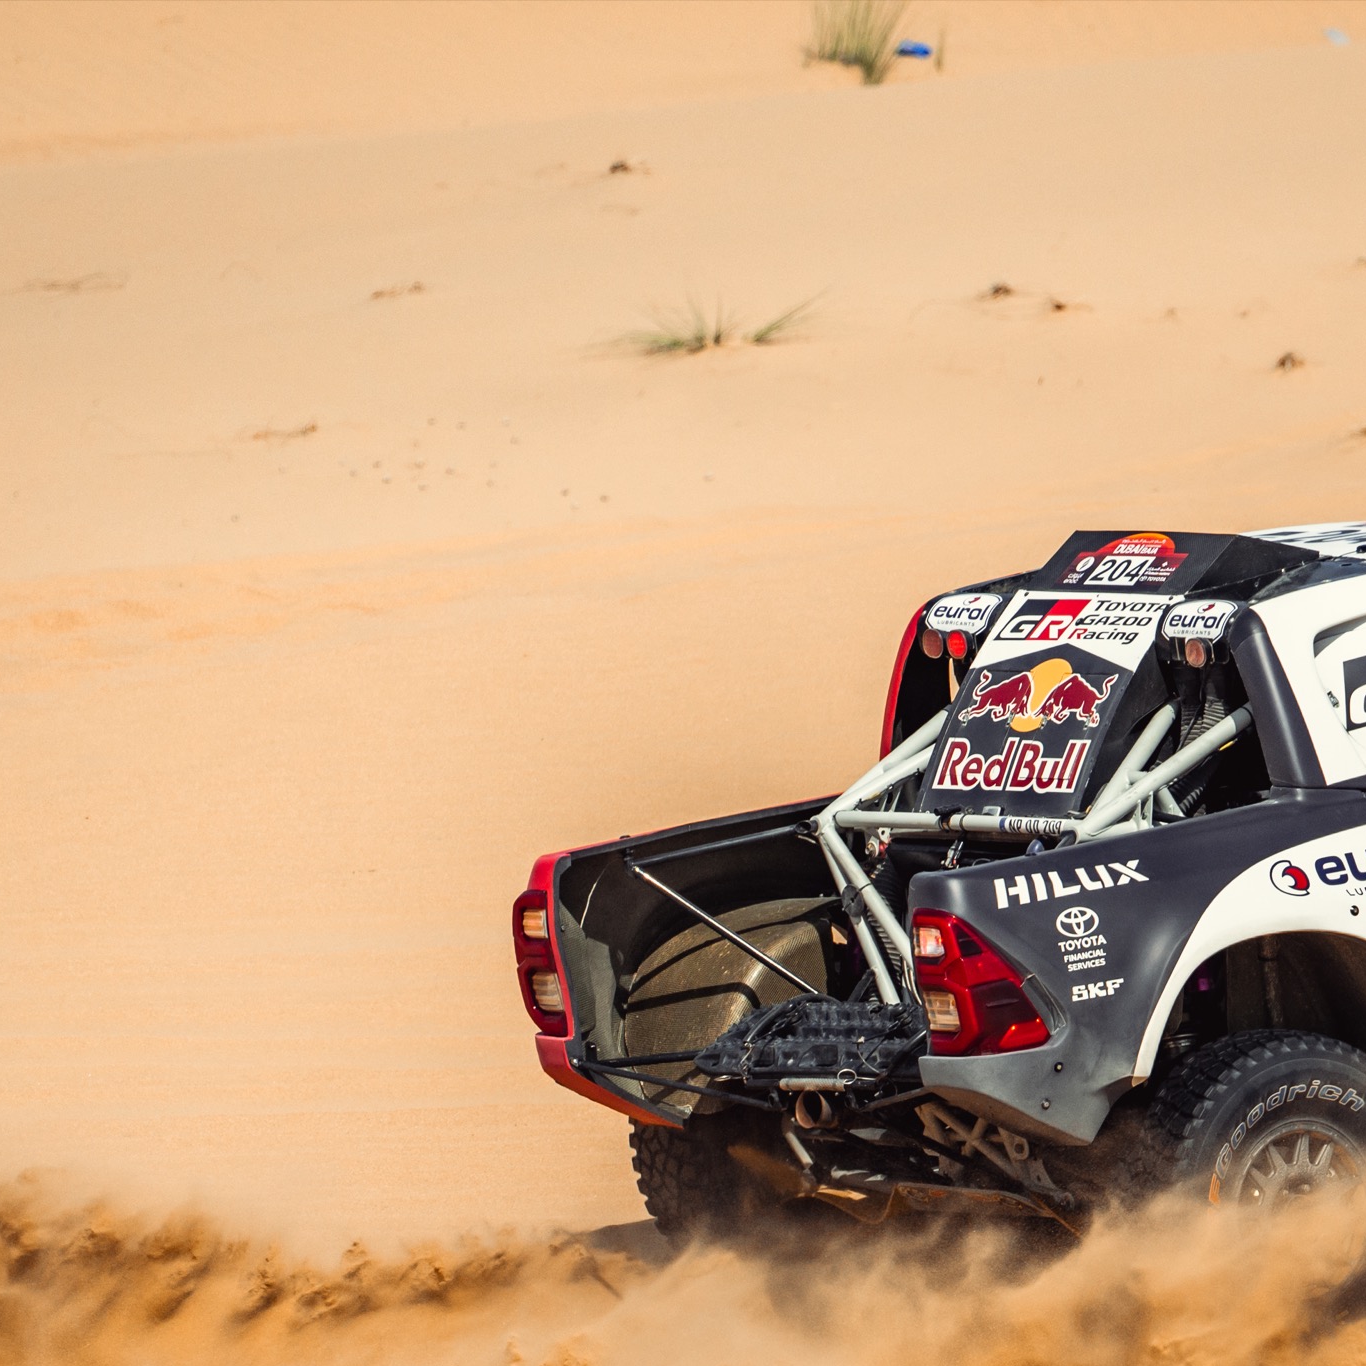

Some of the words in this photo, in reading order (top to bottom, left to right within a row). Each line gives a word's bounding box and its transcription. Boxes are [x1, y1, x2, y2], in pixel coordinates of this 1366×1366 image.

[1089, 559, 1149, 582] 204
[933, 605, 991, 621] eurol
[1096, 600, 1170, 613] TOYOTA
[1083, 614, 1153, 627] GAZOO
[1169, 612, 1227, 629] eurol
[1068, 628, 1139, 645] Racing
[993, 859, 1150, 909] HILUX
[1058, 934, 1107, 953] TOYOTA
[1063, 949, 1107, 963] FINANCIAL
[1067, 958, 1106, 972] SERVICES
[1072, 978, 1125, 1002] SKF
